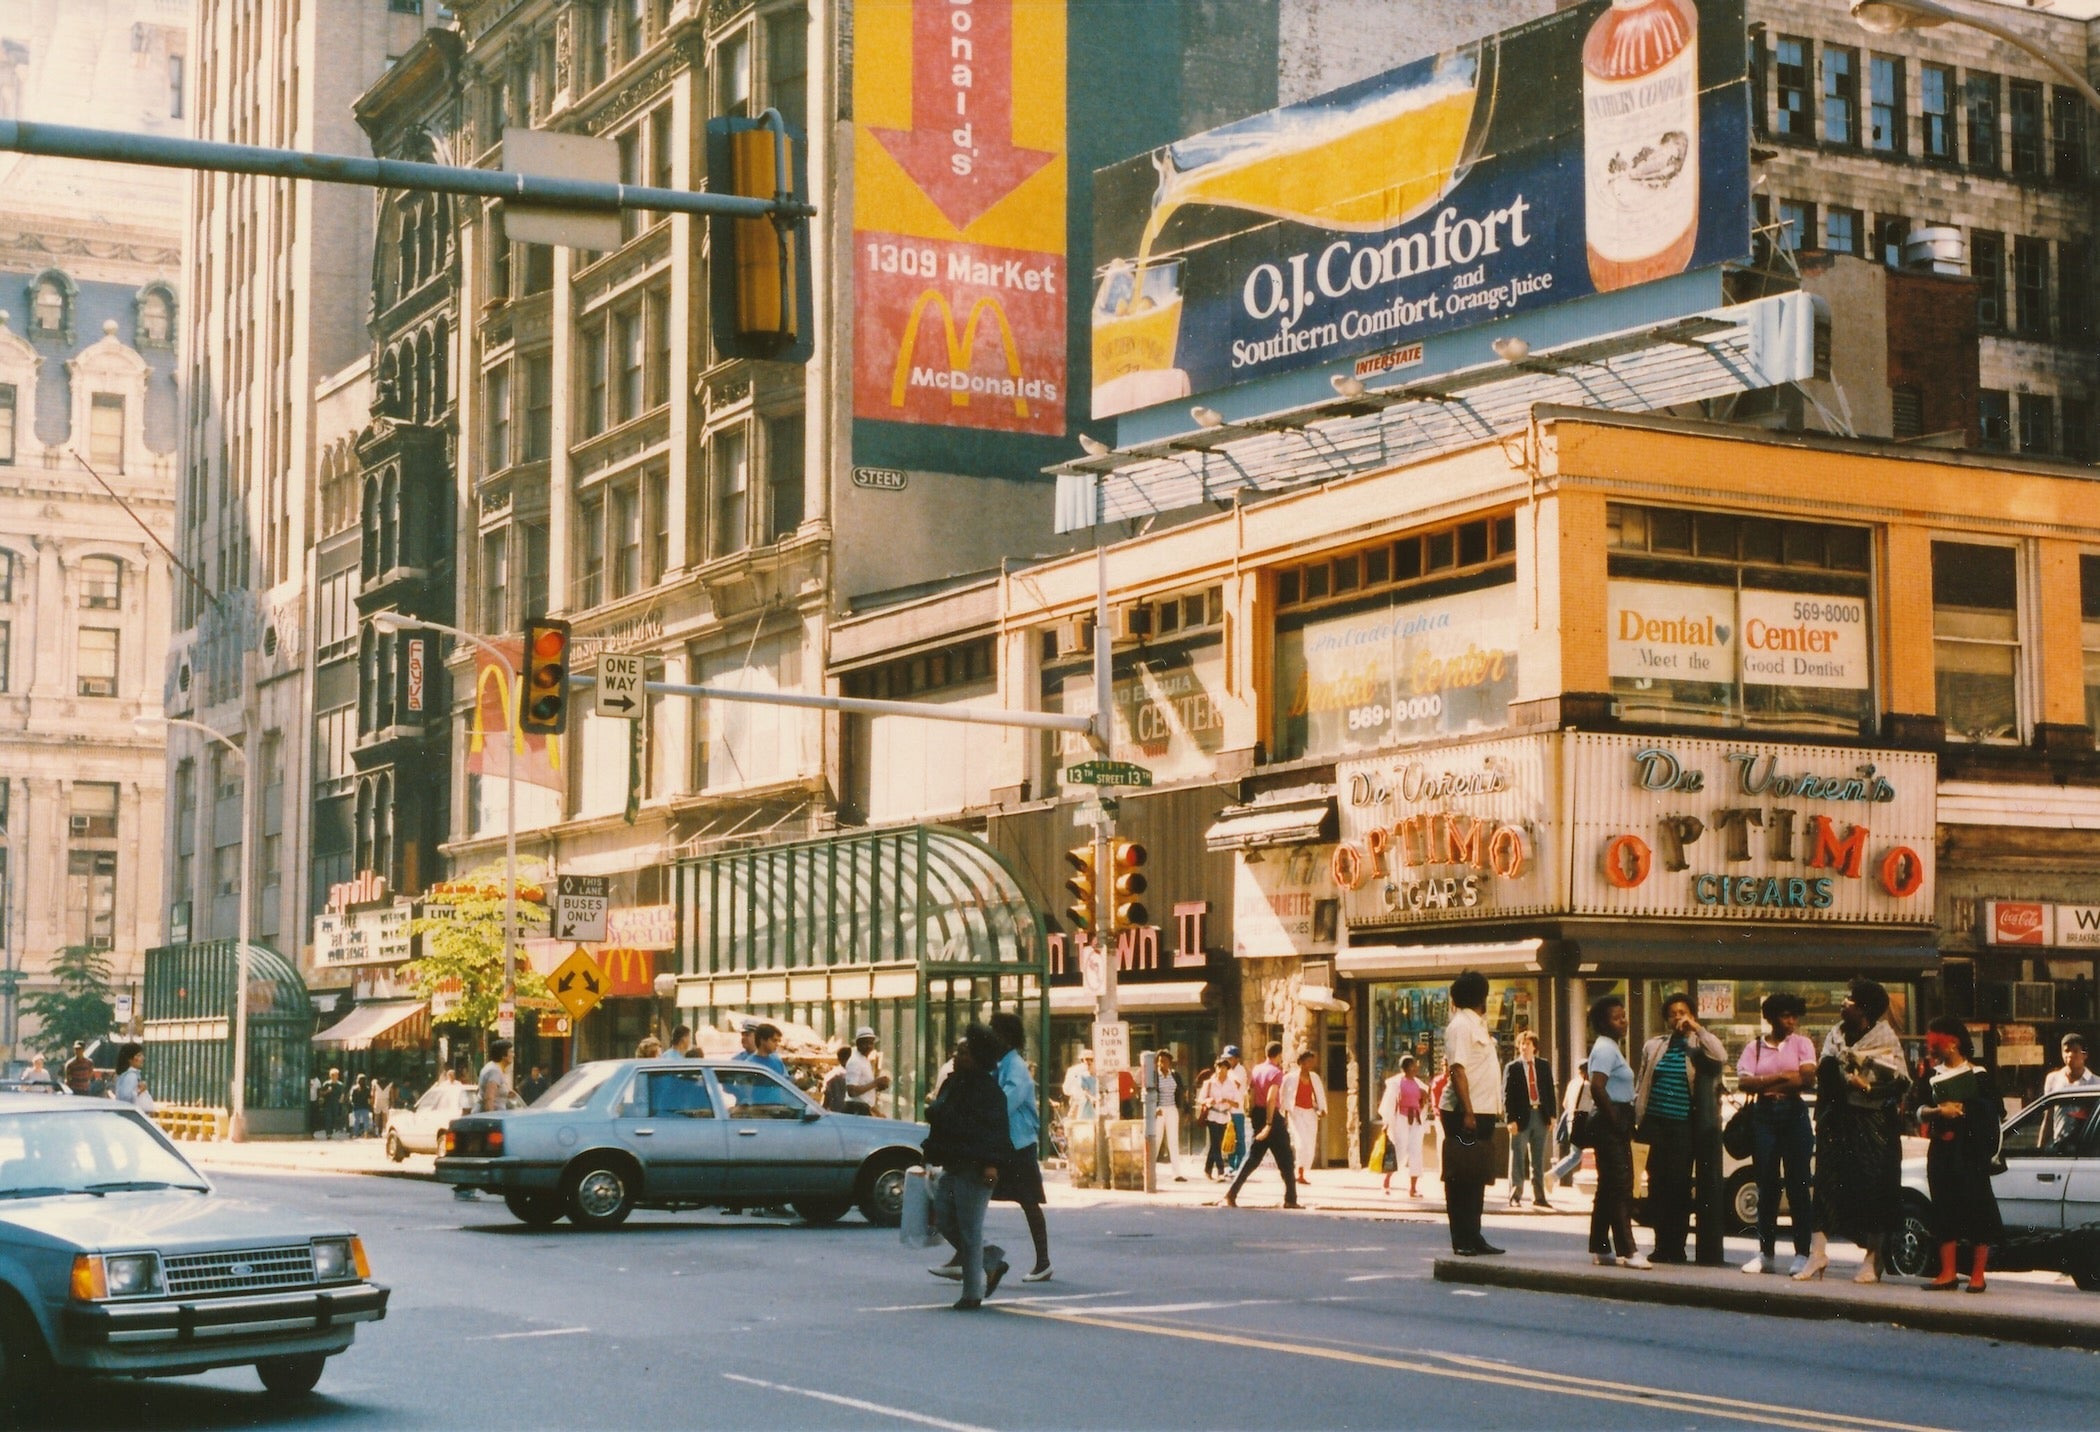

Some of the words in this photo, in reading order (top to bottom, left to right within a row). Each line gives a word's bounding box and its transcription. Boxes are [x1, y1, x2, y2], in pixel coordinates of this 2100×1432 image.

[949, 0, 978, 176] onald's
[867, 243, 937, 279] 1309
[1316, 194, 1531, 298] Comfort
[1453, 264, 1485, 291] and
[1232, 322, 1338, 369] Southern
[1445, 287, 1509, 315] Orange
[1510, 272, 1553, 308] Juice
[1355, 346, 1423, 375] INTERSTATE
[857, 469, 902, 487] STEEN
[1310, 611, 1451, 653] Philadelphia
[1618, 609, 1714, 647] Dental
[1746, 617, 1839, 653] Center
[410, 641, 422, 709] Fayva
[605, 658, 638, 674] ONE
[1411, 643, 1508, 695] Center
[1689, 651, 1711, 670] the
[1744, 655, 1785, 675] Good
[605, 677, 637, 692] WAY
[1096, 773, 1125, 784] STREET
[1348, 771, 1387, 806] De
[1635, 749, 1705, 793] De
[1331, 813, 1527, 890] OPTIMO
[1605, 807, 1924, 898] OPTIMO
[329, 870, 386, 915] apollo
[579, 886, 603, 895] LANE
[581, 877, 603, 886] THIS
[1383, 874, 1479, 912] CIGARS
[1697, 873, 1834, 909] CIGARS
[564, 899, 603, 910] BUSES
[568, 910, 597, 922] ONLY
[1100, 1039, 1122, 1047] TURN
[1102, 1027, 1119, 1037] NO
